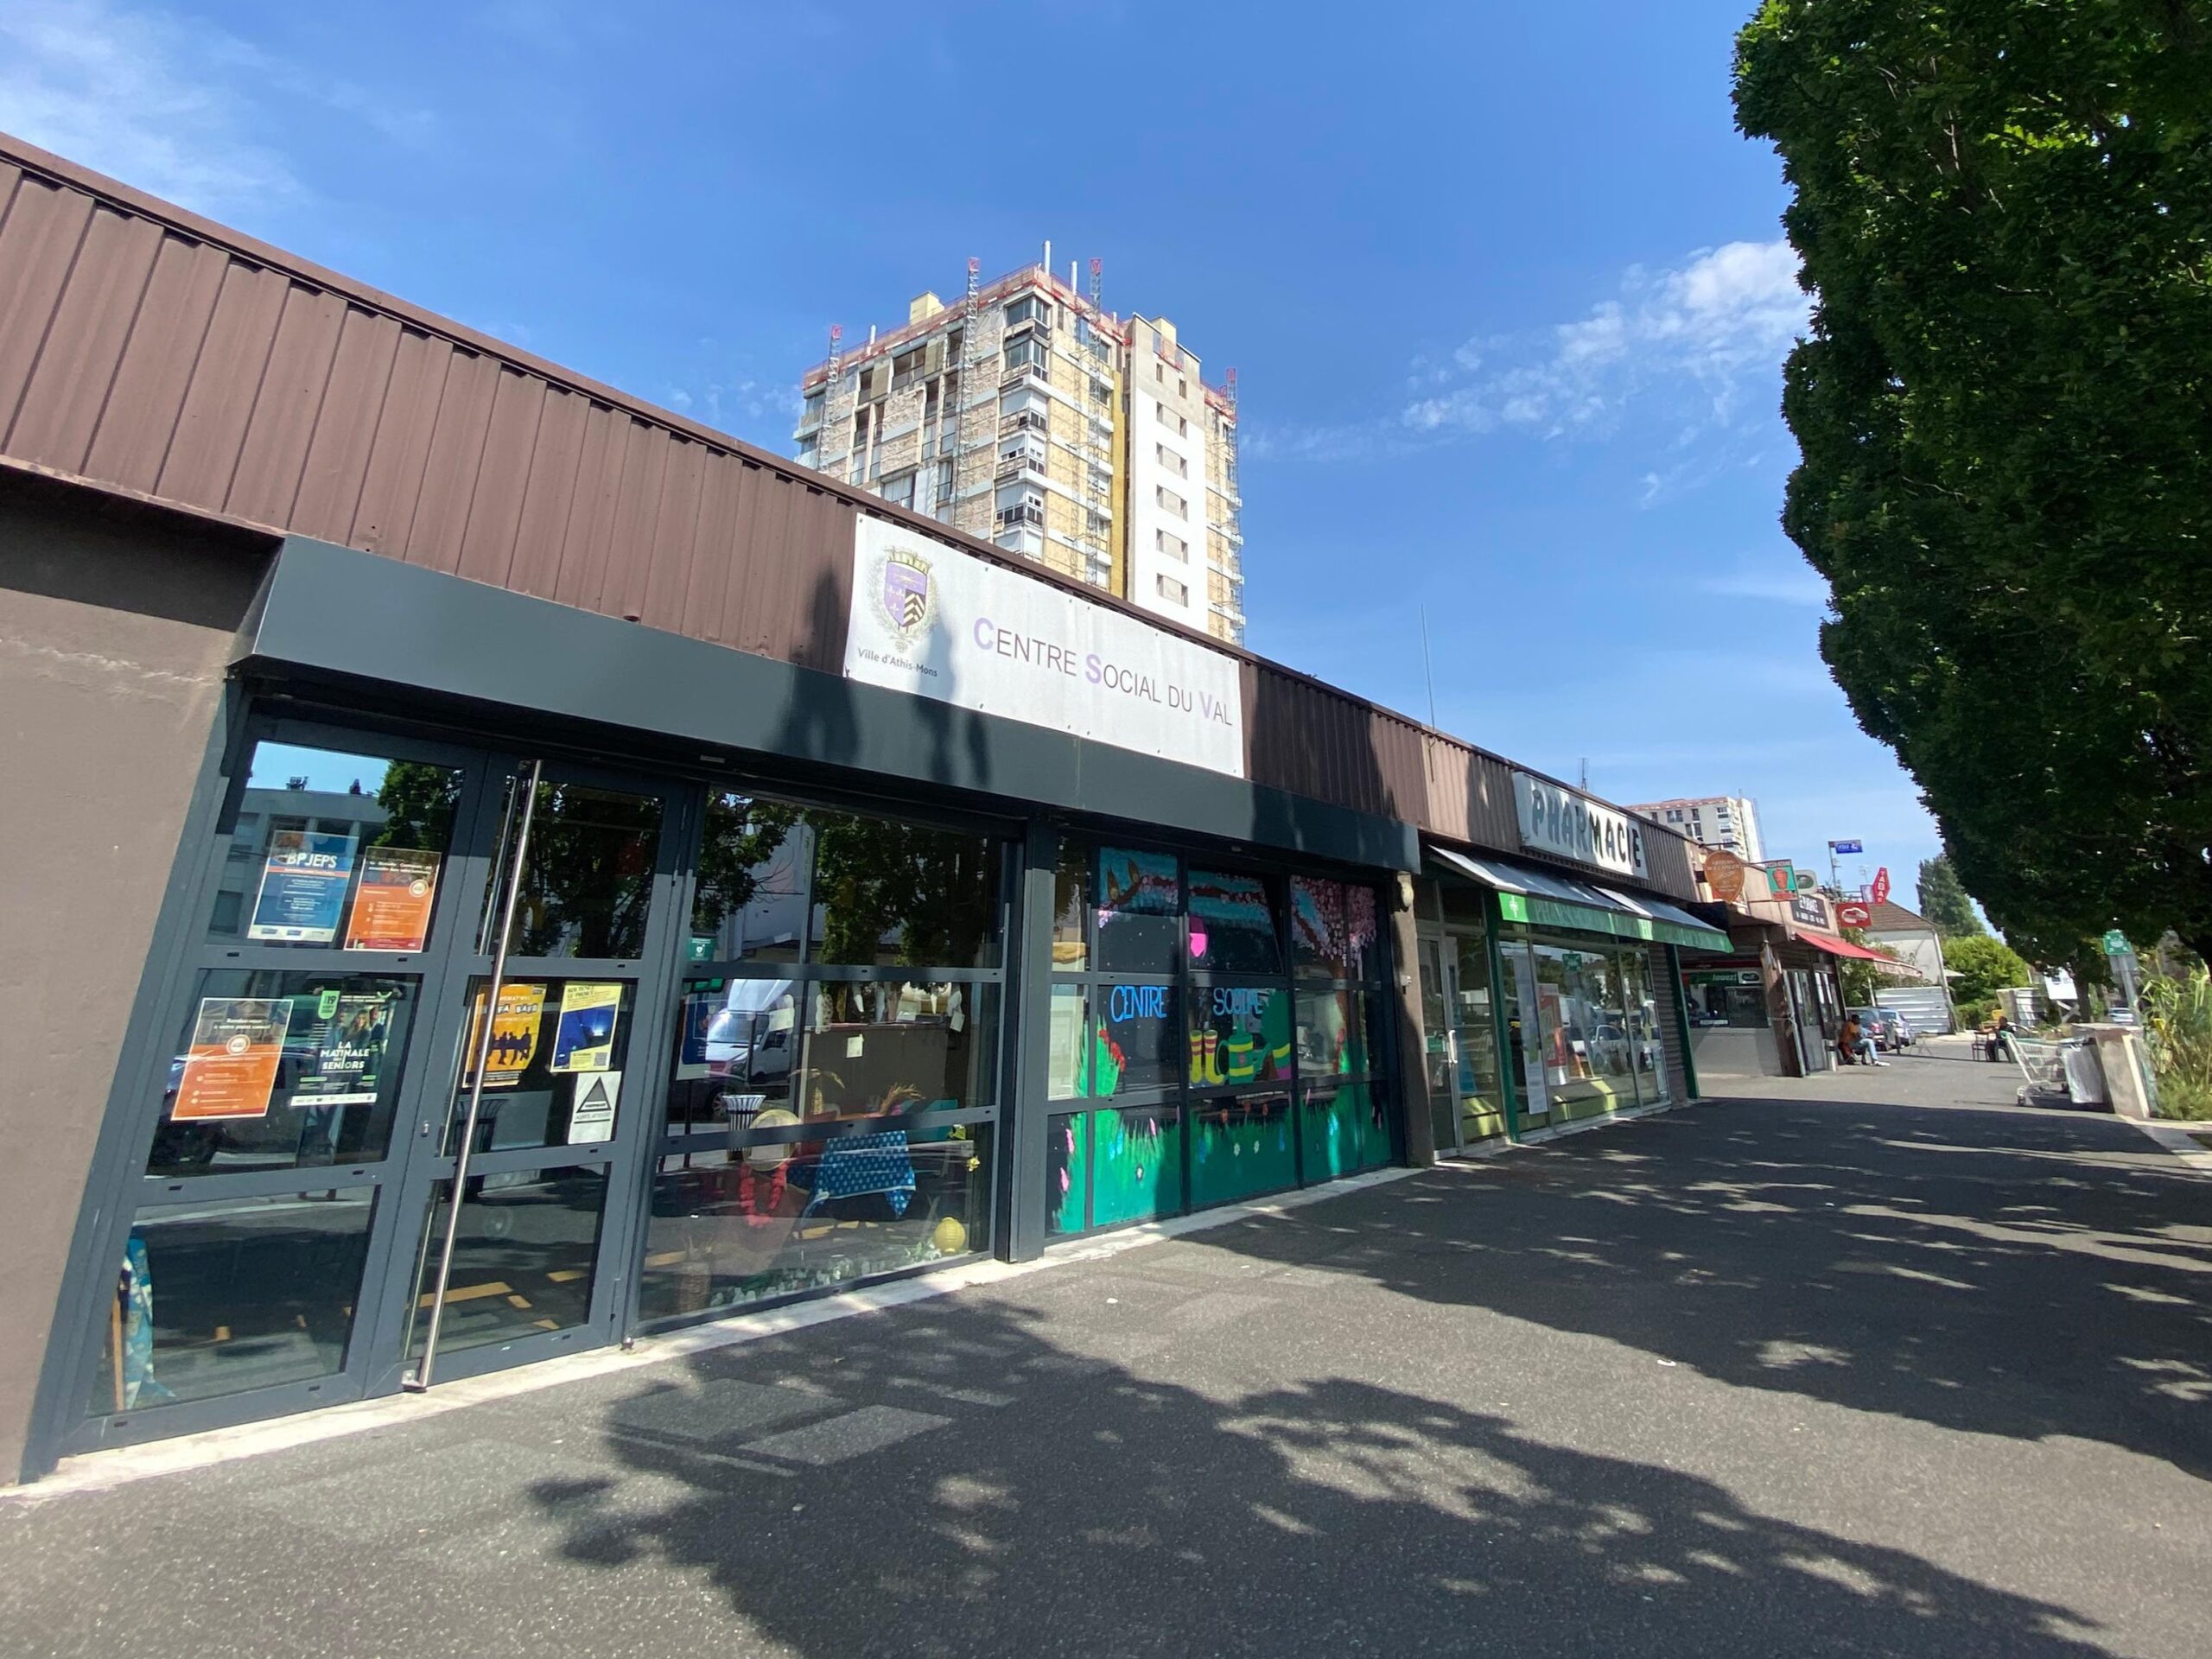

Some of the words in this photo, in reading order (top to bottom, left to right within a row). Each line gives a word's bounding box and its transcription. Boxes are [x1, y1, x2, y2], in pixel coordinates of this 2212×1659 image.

[857, 647, 880, 662] Ville
[881, 653, 938, 677] d'Athis-Mons
[973, 617, 1077, 677] CENTRE
[1084, 653, 1162, 703] SOCIAL
[1168, 684, 1192, 713] DU
[1199, 690, 1234, 727] VAL
[1532, 788, 1642, 868] PHARMACIE
[287, 852, 338, 868] BPJEPS
[1877, 870, 1886, 903] TABAC
[1110, 985, 1168, 1023] CENTRE
[320, 1048, 371, 1058] MATINALE
[338, 1040, 352, 1049] LA
[322, 1060, 365, 1070] SENIORS
